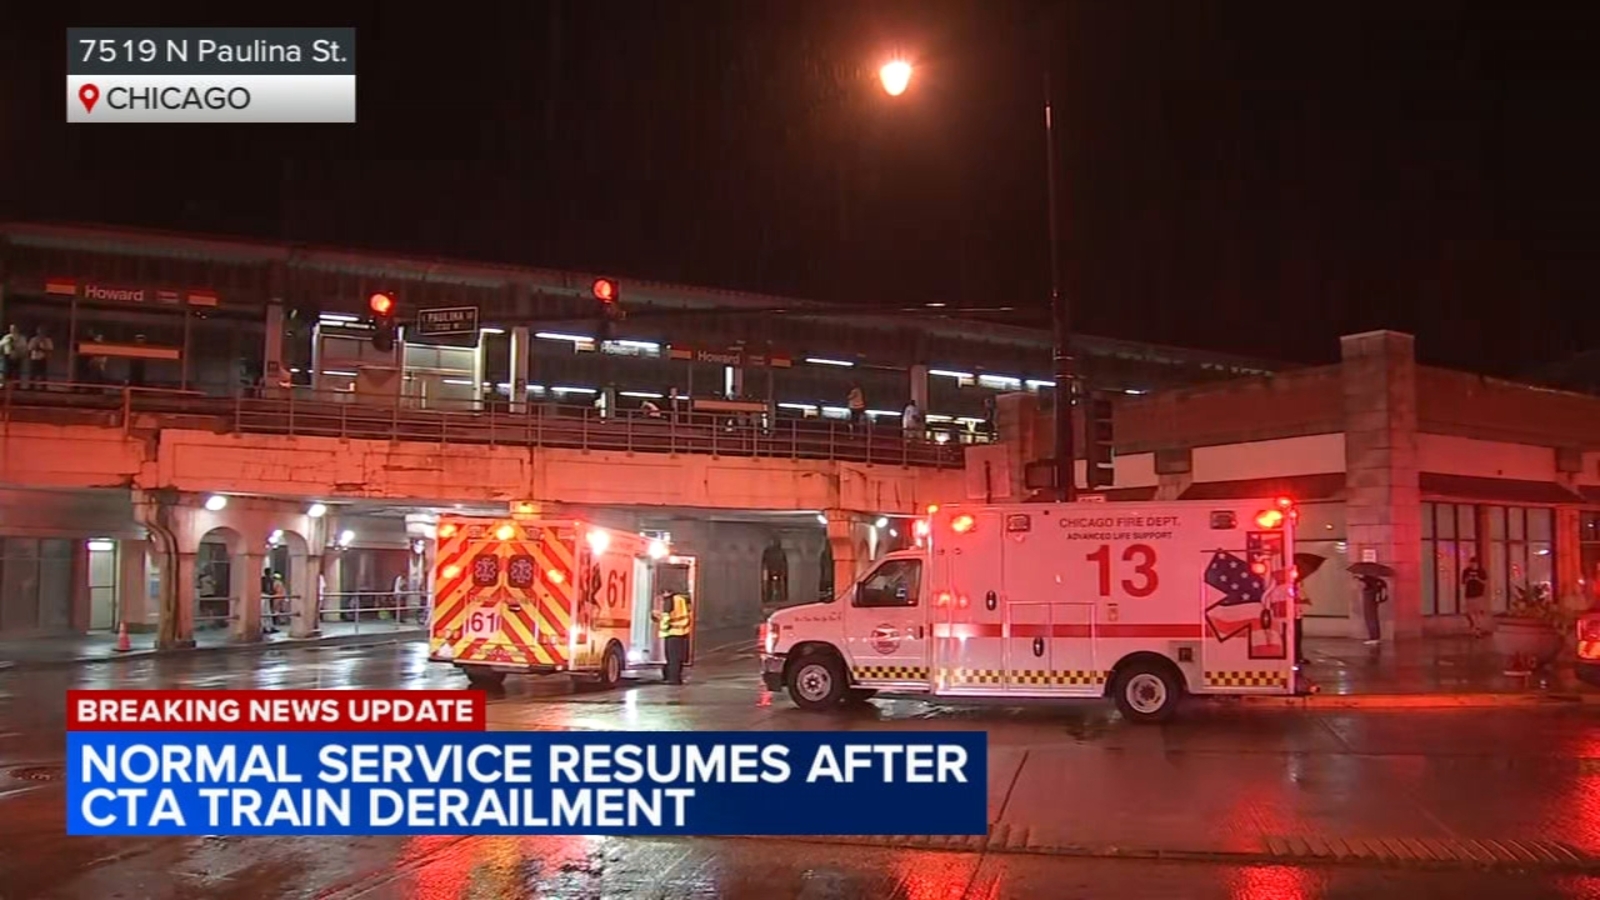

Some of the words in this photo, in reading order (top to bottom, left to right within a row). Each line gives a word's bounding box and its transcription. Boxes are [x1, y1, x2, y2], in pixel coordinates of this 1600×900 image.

[85, 284, 144, 301] Howard
[698, 350, 740, 365] Howard
[1059, 517, 1114, 528] CHICAGO
[1116, 517, 1144, 527] FIRE
[1146, 516, 1181, 527] DEPT.
[1066, 532, 1112, 540] ADVANCED
[1113, 532, 1131, 540] LIFE
[1133, 531, 1172, 540] SUPPORT
[1086, 544, 1159, 598] 13
[607, 569, 627, 608] 61
[471, 612, 496, 633] 61
